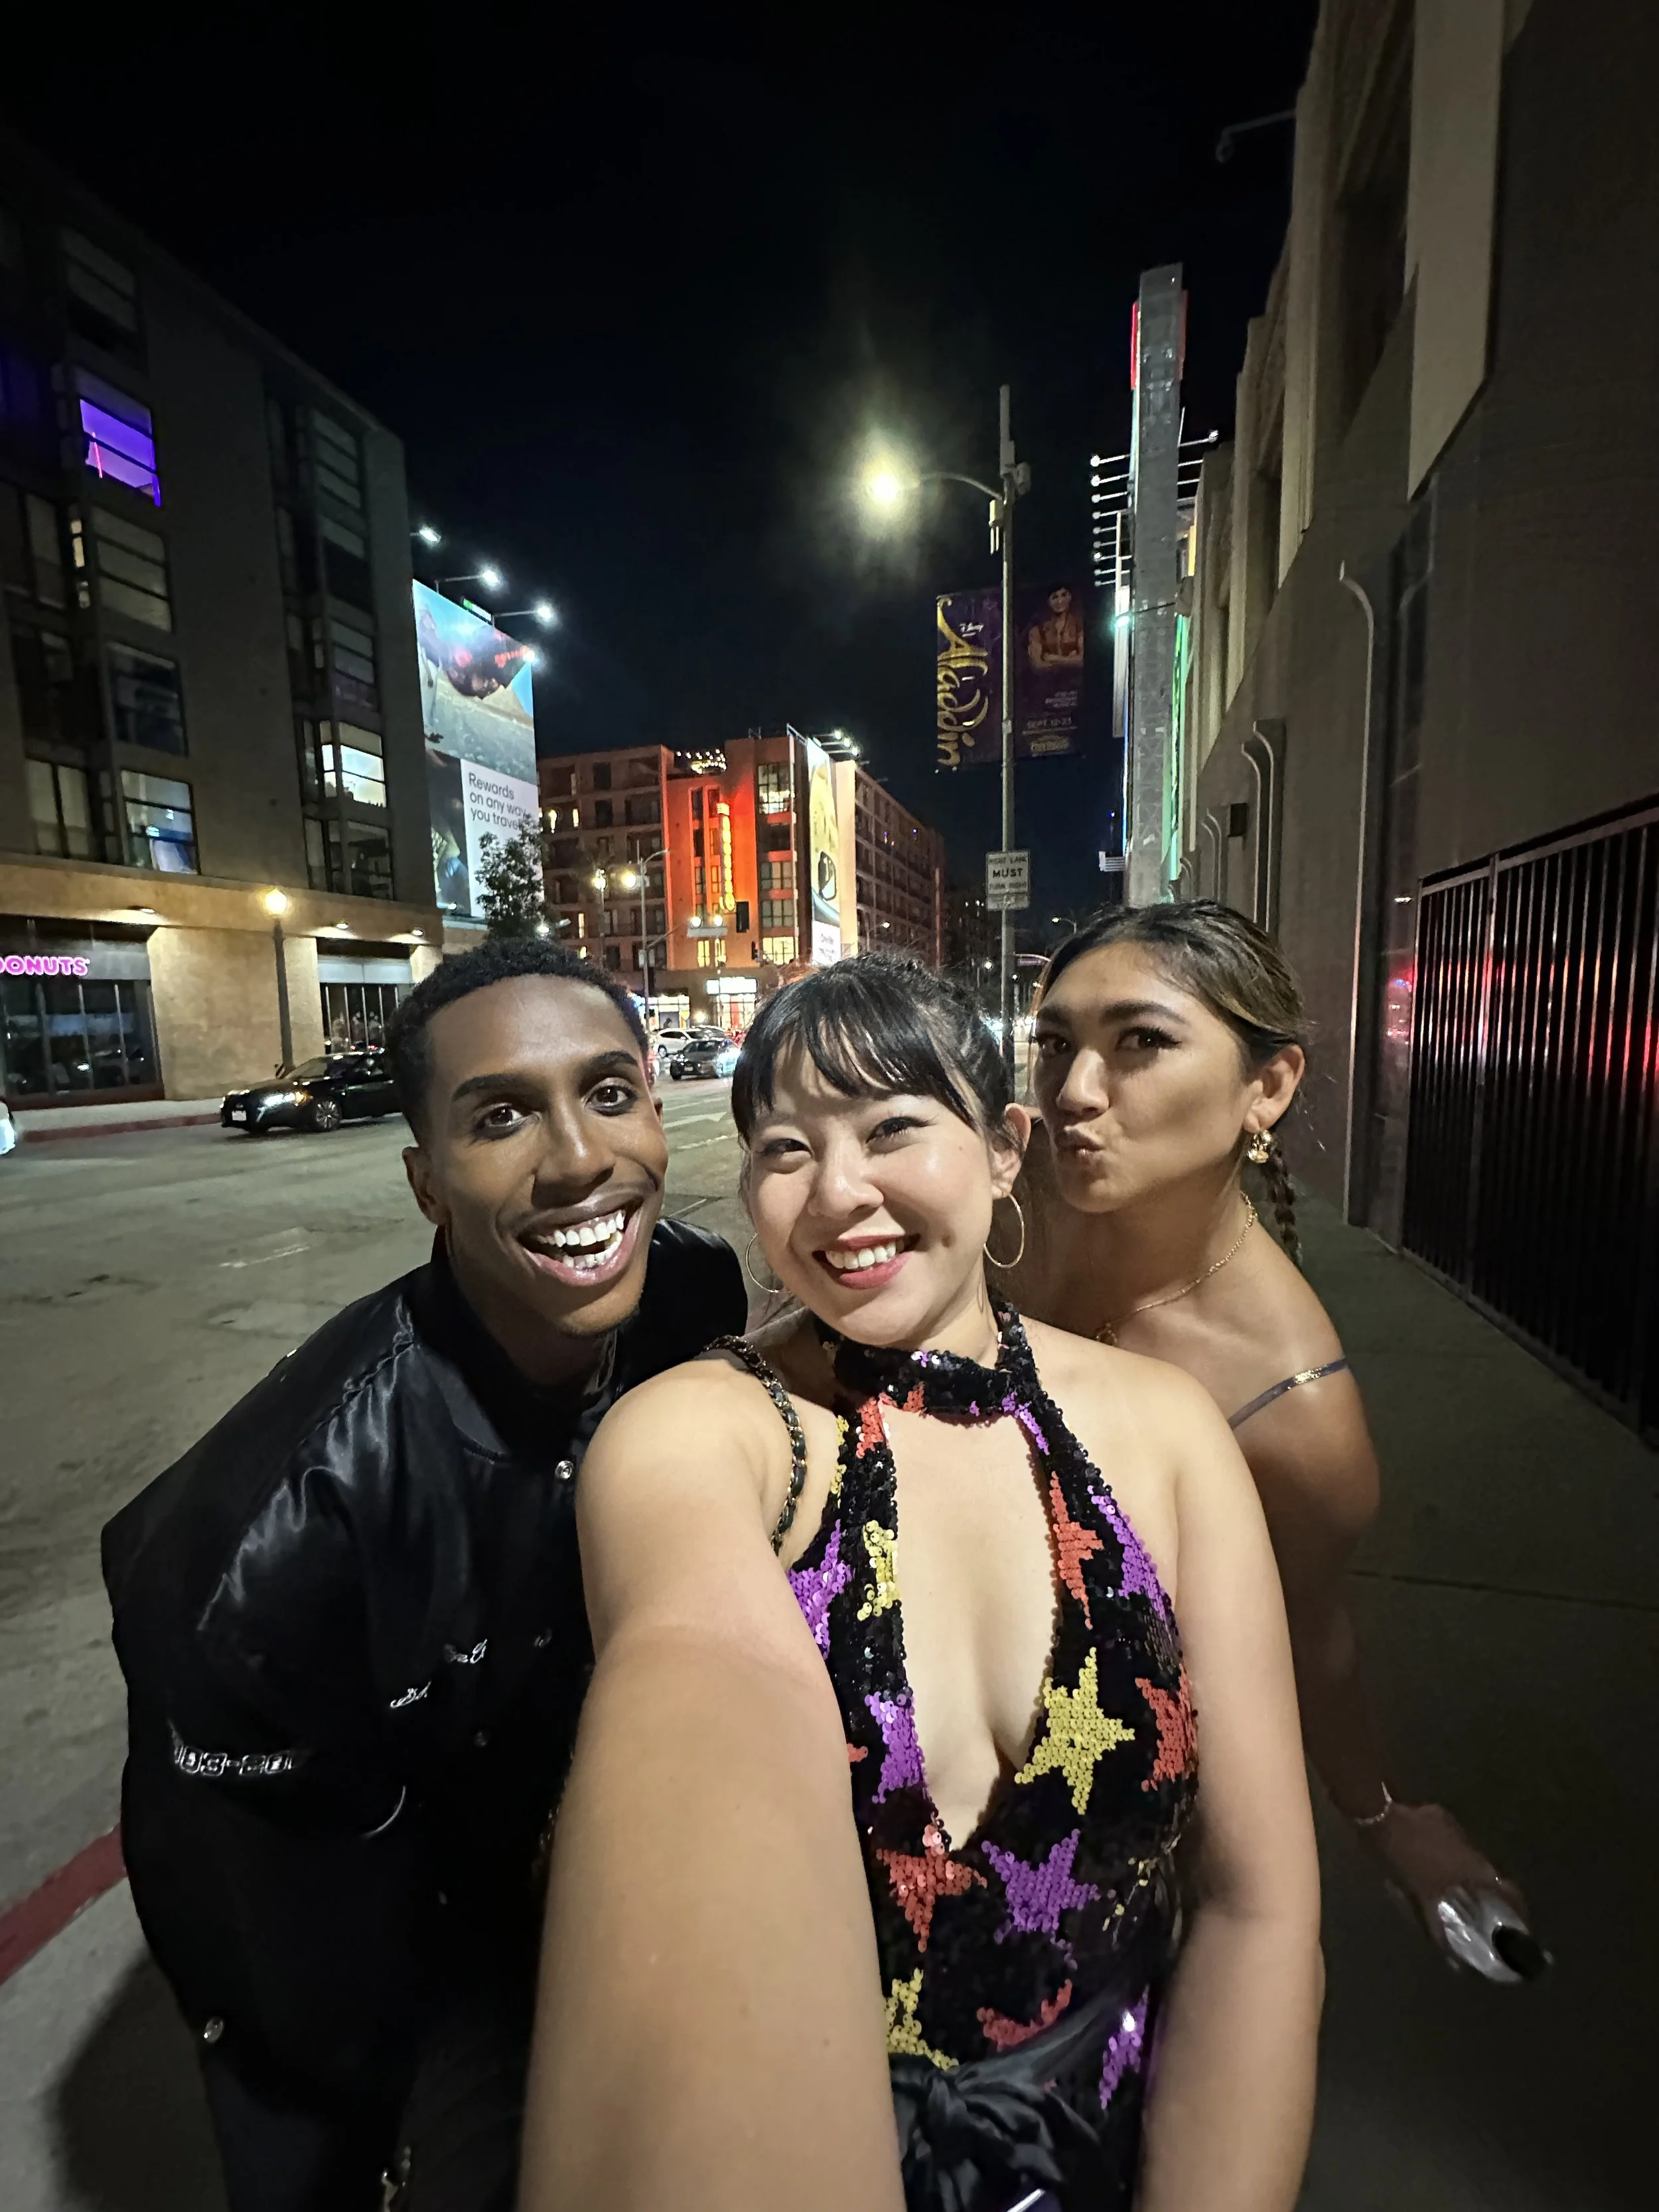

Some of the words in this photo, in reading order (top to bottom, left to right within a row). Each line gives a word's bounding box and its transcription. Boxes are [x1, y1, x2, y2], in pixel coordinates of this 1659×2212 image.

[936, 597, 988, 766] Aladdin
[469, 772, 514, 800] Rewards
[470, 792, 484, 805] on
[486, 797, 505, 814] any
[506, 804, 526, 820] way
[470, 808, 490, 822] you
[993, 867, 1023, 879] MUST
